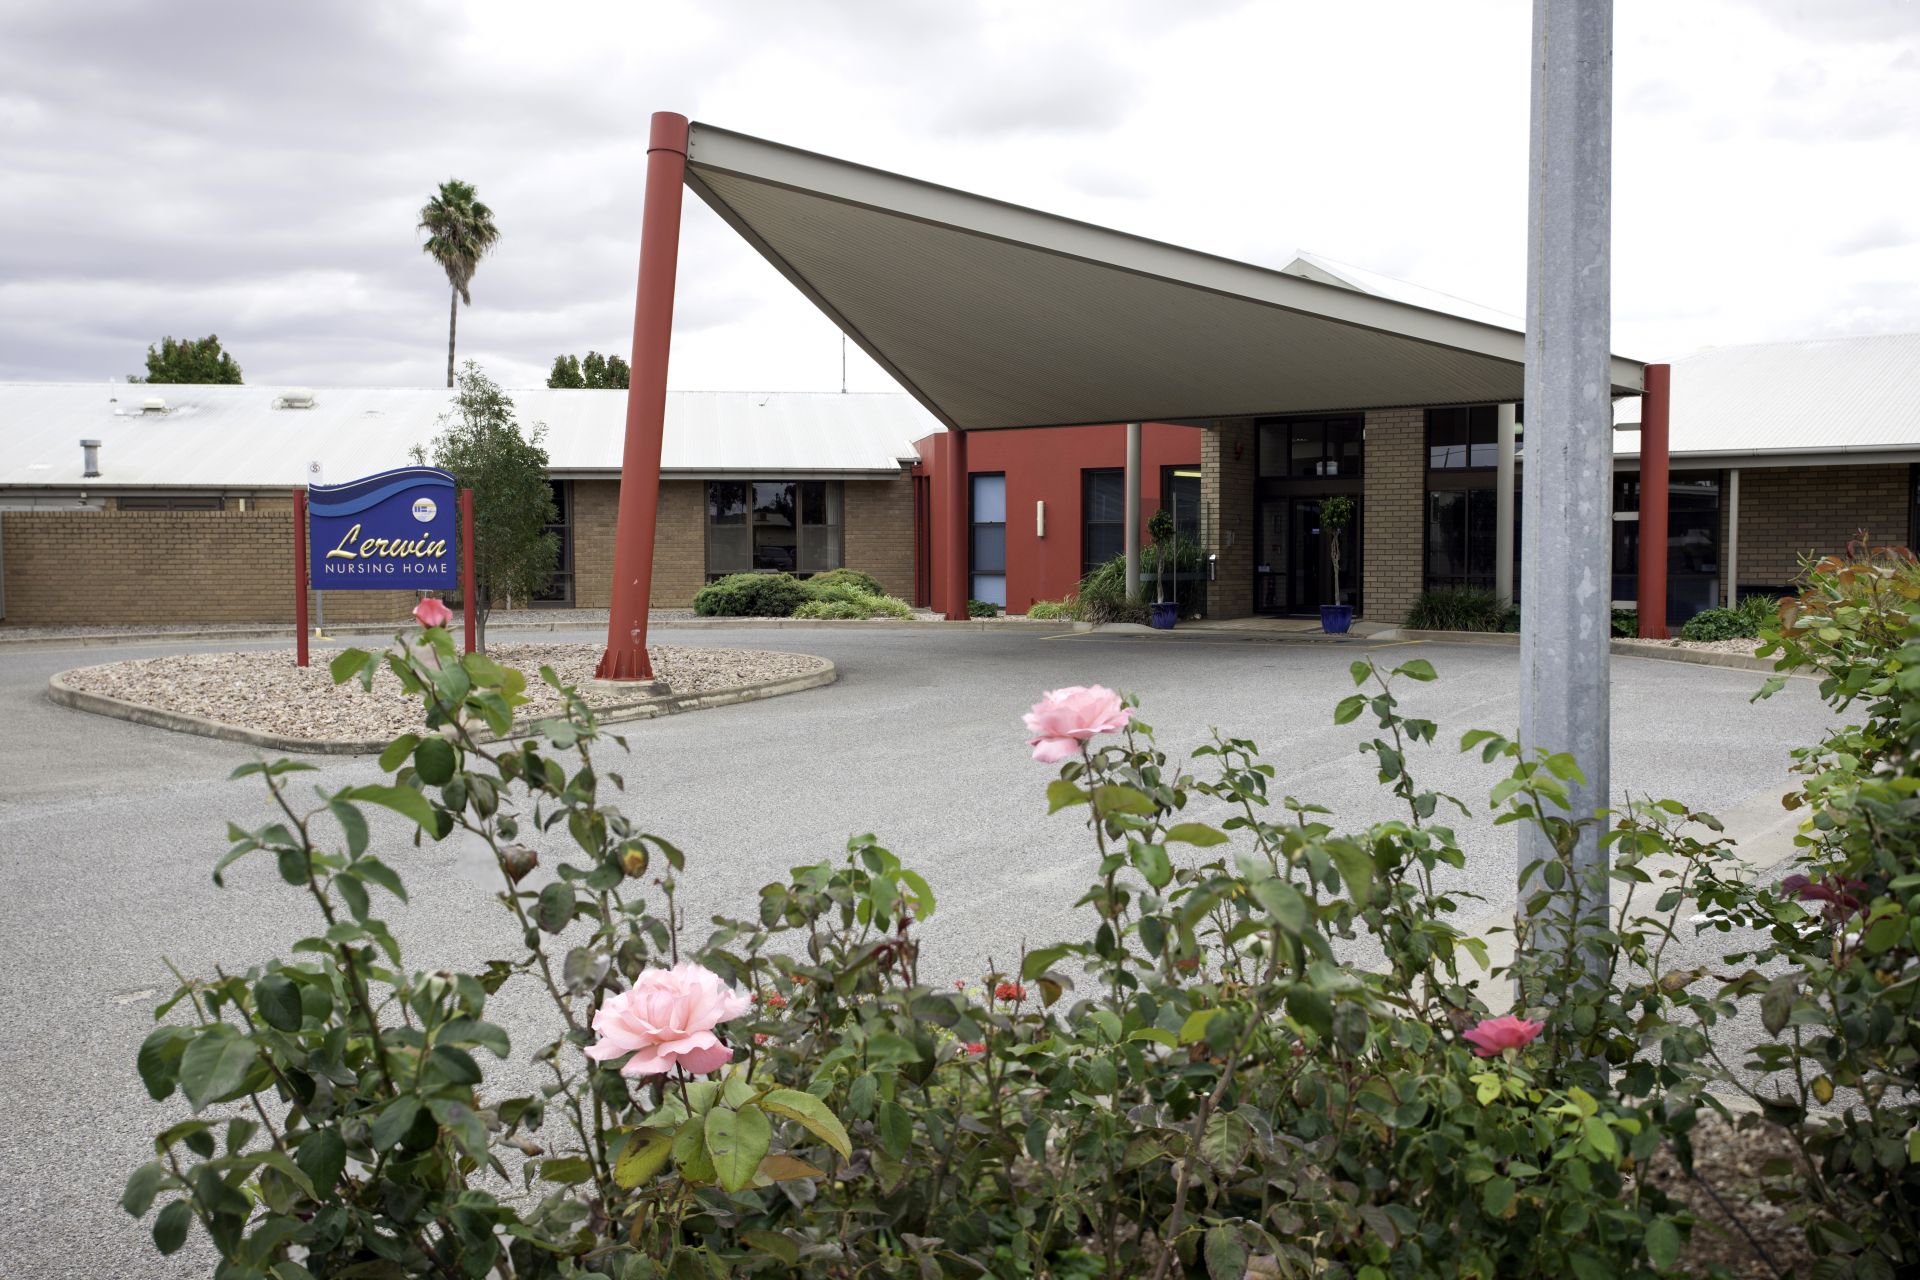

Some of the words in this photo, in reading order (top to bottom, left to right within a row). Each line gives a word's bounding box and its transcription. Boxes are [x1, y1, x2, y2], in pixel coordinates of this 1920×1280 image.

[326, 523, 447, 560] Lerwin
[325, 563, 395, 574] NURSING
[403, 563, 447, 574] HOME
